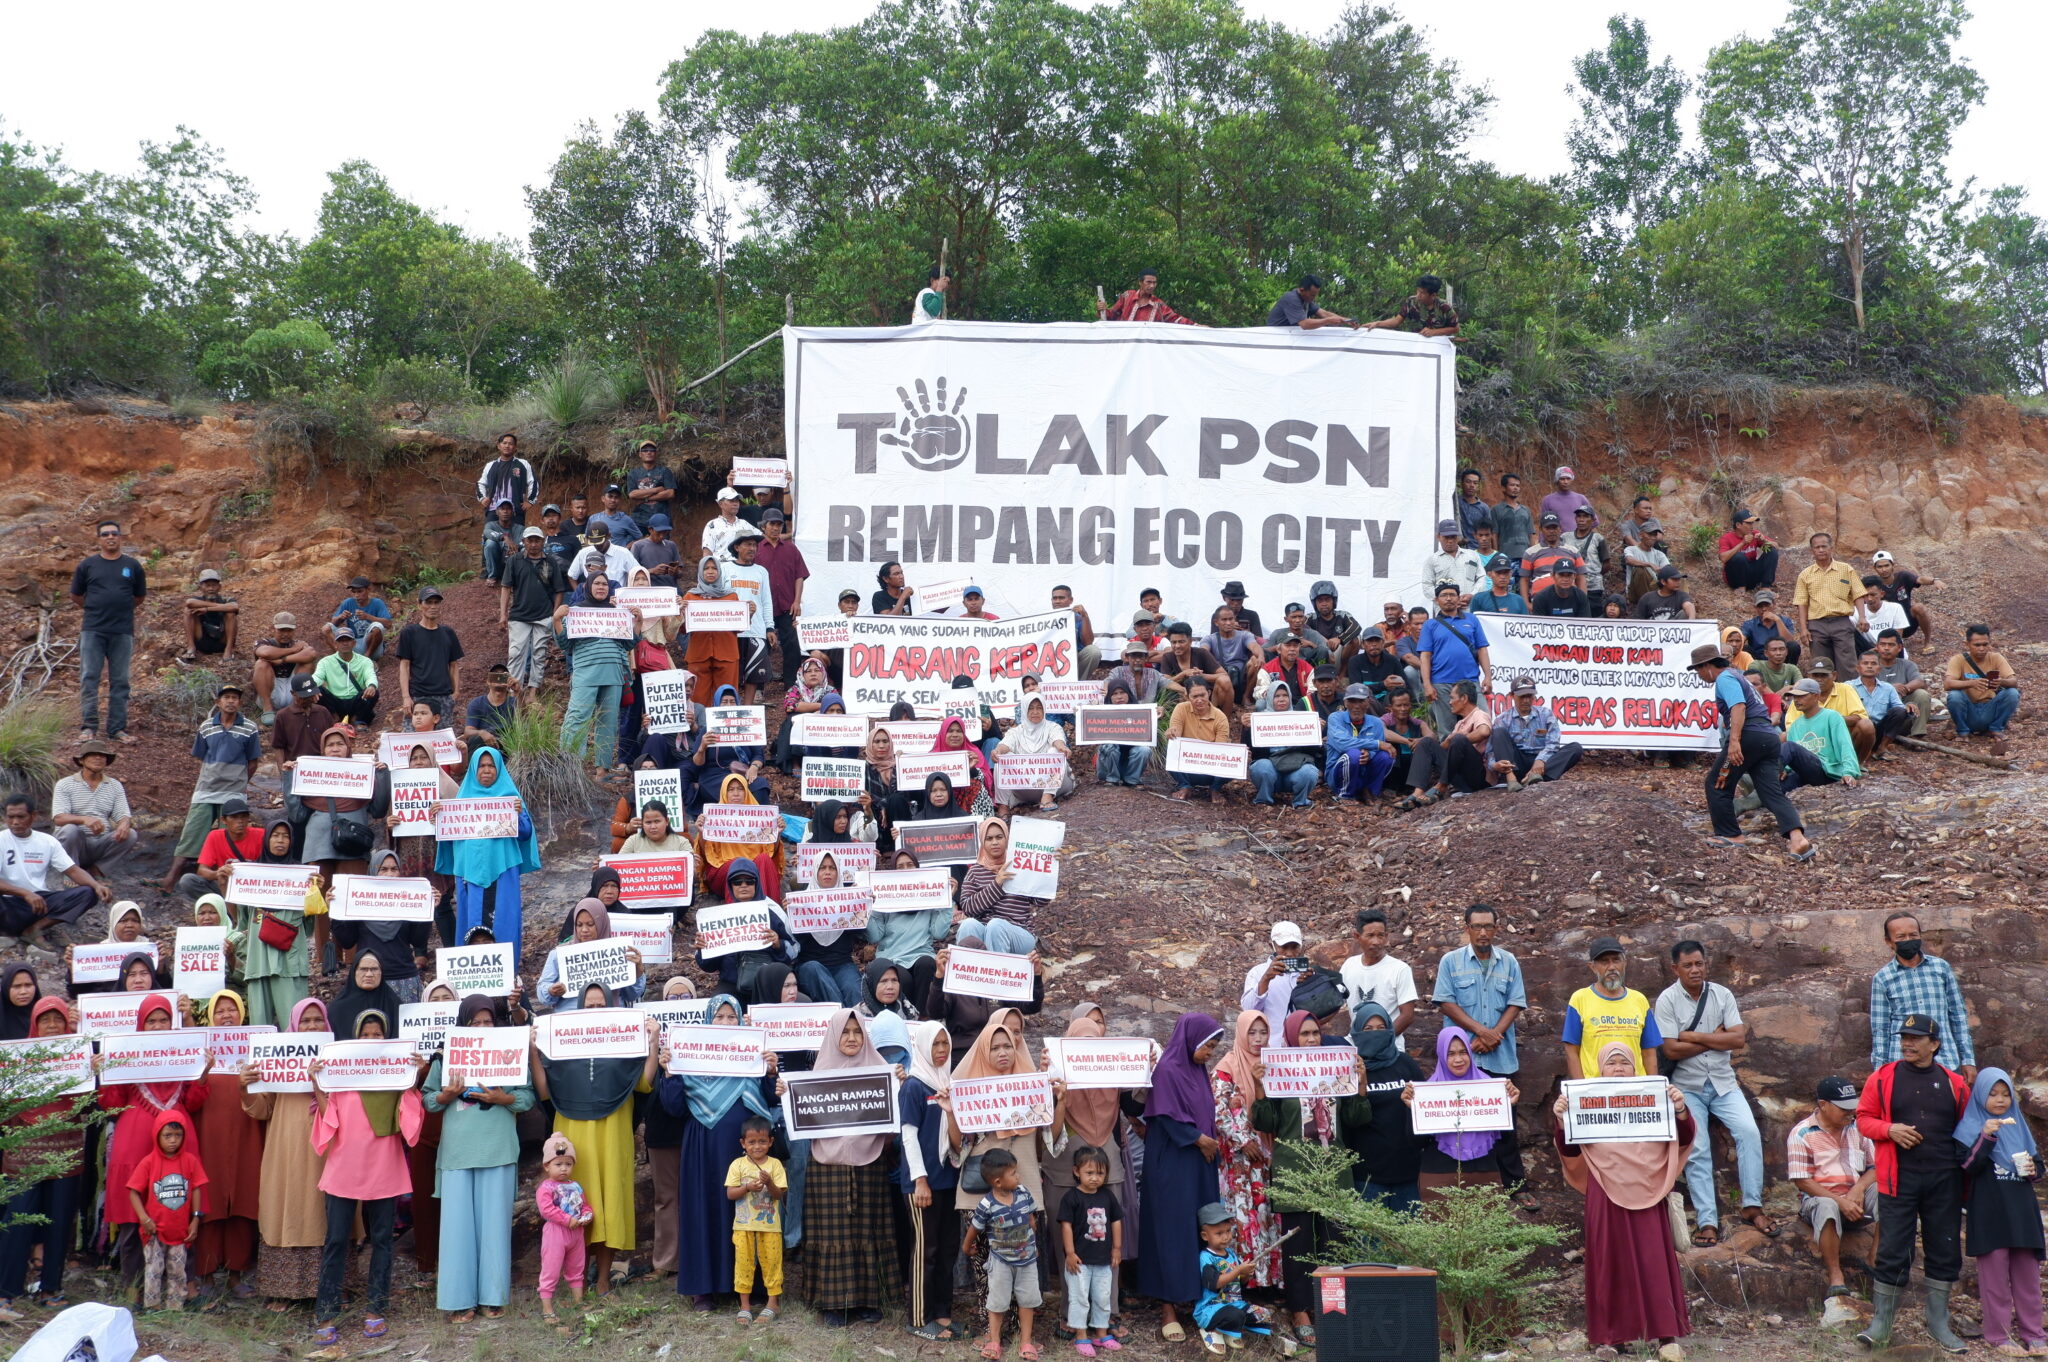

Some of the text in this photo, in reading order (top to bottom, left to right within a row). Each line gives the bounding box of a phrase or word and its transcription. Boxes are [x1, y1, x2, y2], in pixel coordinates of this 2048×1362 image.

[836, 393, 1390, 488] TOLAK PSN
[736, 466, 752, 474] KAMI
[826, 504, 1402, 578] REMPANG ECO CITY
[800, 620, 848, 631] REMPANG
[852, 618, 1068, 638] KEPADA YANG SUDAH PINDAH RELOKASI
[802, 628, 848, 637] MENOLAK
[1504, 622, 1690, 643] KAMPUNG TEMPAT HIDUP KAMI
[802, 635, 849, 644] TUMBANG
[1532, 644, 1663, 666] JANGAN USIR KAMI
[850, 640, 1070, 682] DILARANG KERAS
[1490, 666, 1675, 688] DARI KAMPUNG NENEK MOYANG
[646, 683, 682, 695] PUTEH
[648, 692, 684, 703] TULANG
[856, 688, 906, 705] BALEK
[648, 704, 685, 715] PUTEH
[945, 700, 974, 708] TOLAK
[945, 707, 976, 719] PSN
[1551, 696, 1719, 730] KERAS RELOKASI
[651, 713, 686, 727] MATE
[823, 763, 833, 771] US
[836, 764, 861, 772] JUSTICE
[300, 769, 368, 780] KAMI MENOLAK
[639, 777, 677, 787] JANGAN
[807, 777, 860, 788] OWNER OF
[395, 788, 436, 801] MATI
[639, 785, 677, 796] RUSAK
[806, 788, 836, 796] REMPANG
[439, 802, 513, 812] HIDUP KORBAN
[441, 813, 512, 824] JANGAN DIAM
[441, 826, 475, 835] LAWAN
[905, 833, 974, 844] TOLAK RELOKASI
[1015, 842, 1055, 852] REMPANG
[7, 850, 15, 865] 2
[1014, 850, 1053, 861] NOT FOR
[648, 865, 682, 873] RAMPAS
[1013, 857, 1052, 873] SALE
[700, 913, 767, 932] HENTIKAN
[181, 944, 220, 952] REMPANG
[706, 938, 726, 949] YANG
[202, 952, 219, 960] FOR
[447, 954, 502, 968] TOLAK
[565, 946, 626, 965] HENTIKAN
[180, 960, 219, 972] SALE
[567, 957, 628, 974] INTIMIDASI
[447, 967, 503, 976] PERAMPASAN
[568, 965, 628, 981] MASYARAKAT
[952, 963, 1029, 981] KAMI MENOLAK
[955, 974, 1023, 988] DIRELOKASI GESER
[403, 1018, 431, 1027] MATI
[1601, 1016, 1638, 1025] GRC board
[555, 1025, 640, 1037] KAMI MENOLAK
[450, 1037, 484, 1048] DON'T
[560, 1035, 636, 1045] DIRELOKASI GESER
[674, 1041, 759, 1053] KAMI MENOLAK
[109, 1047, 200, 1060] KAMI MENOLAK
[449, 1048, 524, 1065] DESTROY
[678, 1052, 754, 1062] DIRELOKASI GESER
[1066, 1053, 1149, 1063] KAMI MENOLAK
[1268, 1053, 1351, 1063] HIDUP KORBAN
[168, 1058, 196, 1066] GESER
[323, 1057, 410, 1067] KAMI MENOLAK
[328, 1068, 374, 1076] DIRELOKASI
[449, 1067, 521, 1078] OUR LIVELIHOOD
[1117, 1064, 1145, 1072] GESER
[1268, 1066, 1350, 1077] JANGAN DIAM
[955, 1079, 1045, 1096] HIDUP KORBAN
[1268, 1081, 1309, 1091] LAWAN
[797, 1088, 885, 1105] JANGAN RAMPAS
[1580, 1095, 1655, 1109] KAMI MENOLAK
[958, 1094, 1045, 1111] JANGAN DIAM
[1419, 1098, 1503, 1109] KAMI MENOLAK
[797, 1101, 886, 1116] MASA DEPAN KAMI
[1425, 1108, 1468, 1118] DIRELOKASI
[959, 1113, 1001, 1126] LAWAN
[1576, 1112, 1661, 1125] DIRELOKASI DIGESER
